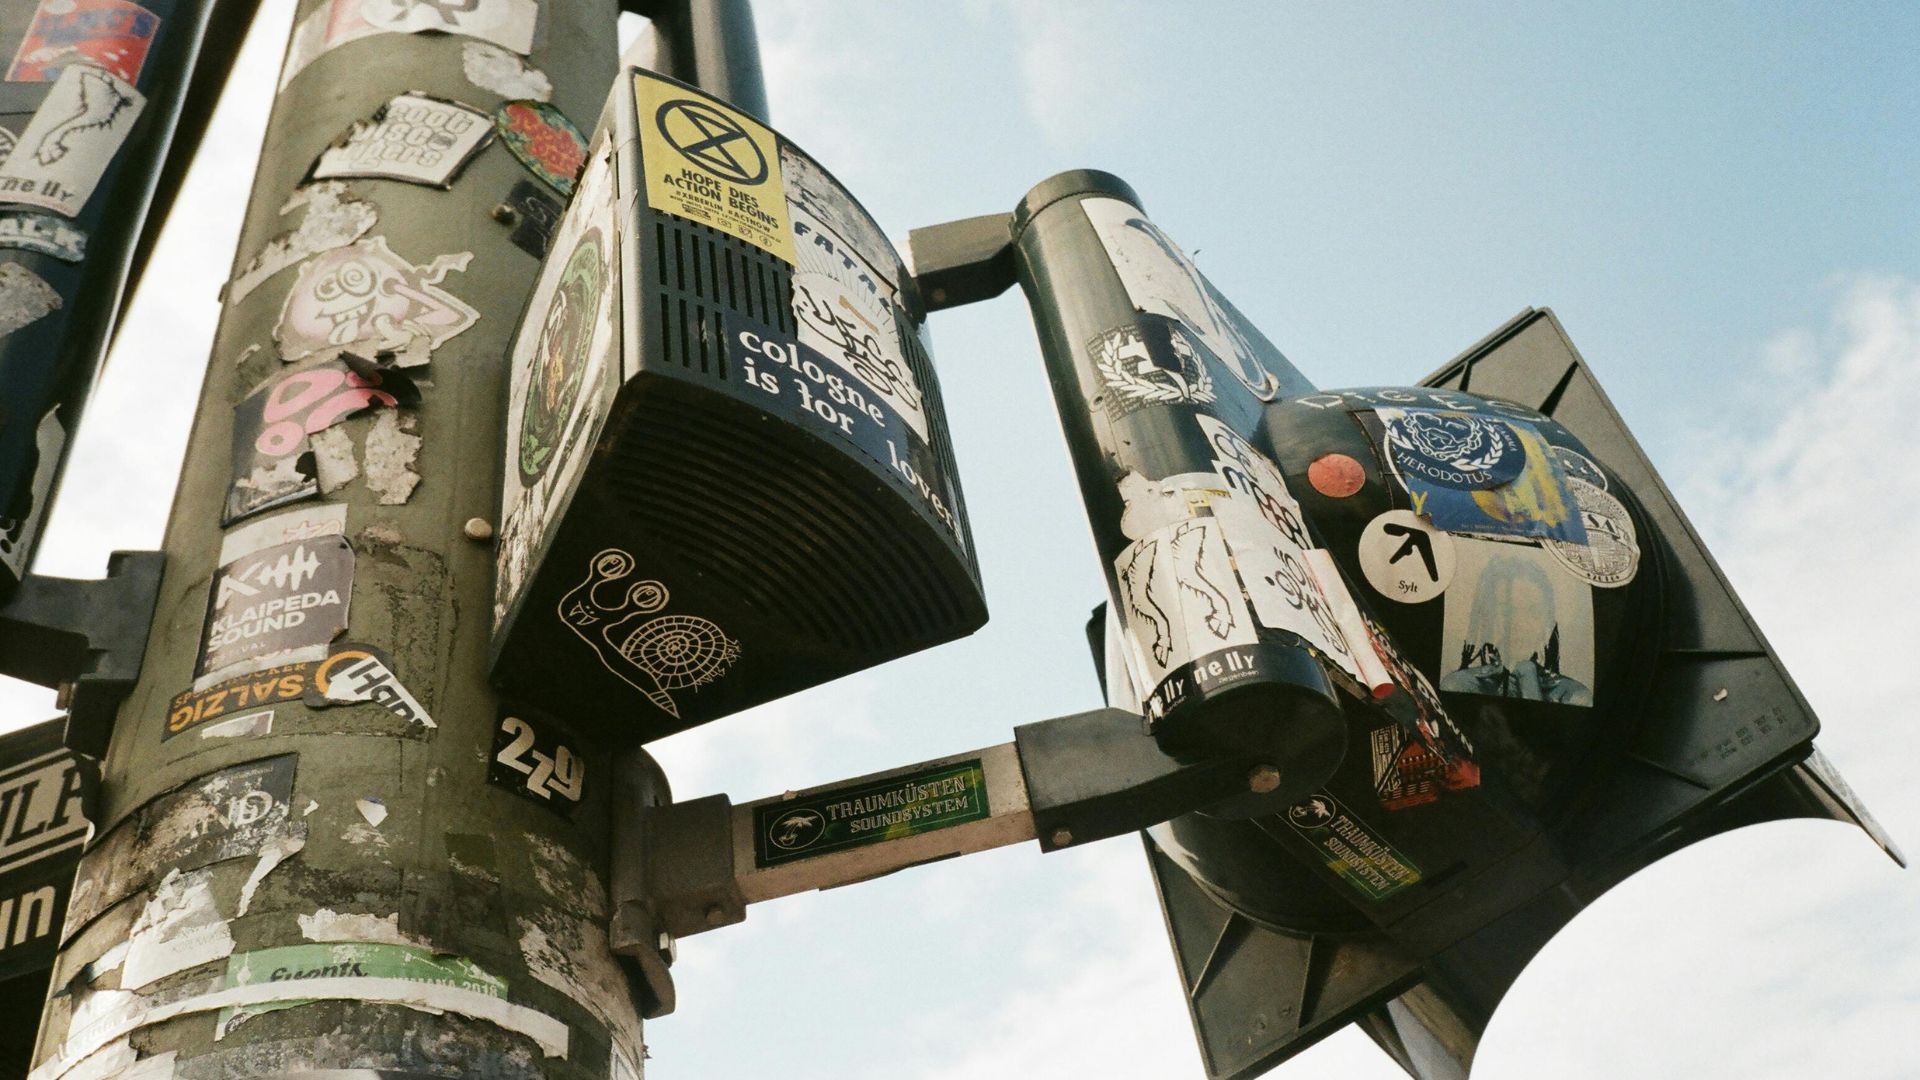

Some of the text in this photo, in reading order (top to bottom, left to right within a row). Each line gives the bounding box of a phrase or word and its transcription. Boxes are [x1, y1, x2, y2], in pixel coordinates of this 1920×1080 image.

[663, 173, 722, 202] ACTION
[728, 196, 779, 229] BEGINS
[681, 168, 759, 209] HOPE DIES
[739, 331, 885, 428] cologne
[744, 357, 780, 395] is
[1395, 450, 1494, 485] HERODOTUS
[1398, 579, 1418, 594] Sylt
[207, 611, 306, 654] SOUND
[211, 589, 341, 636] KLAIPEDA
[169, 674, 305, 733] SALZIG
[826, 775, 967, 821] TRAUMKÜSTEN
[850, 795, 969, 834] SOUNDSYSTEM
